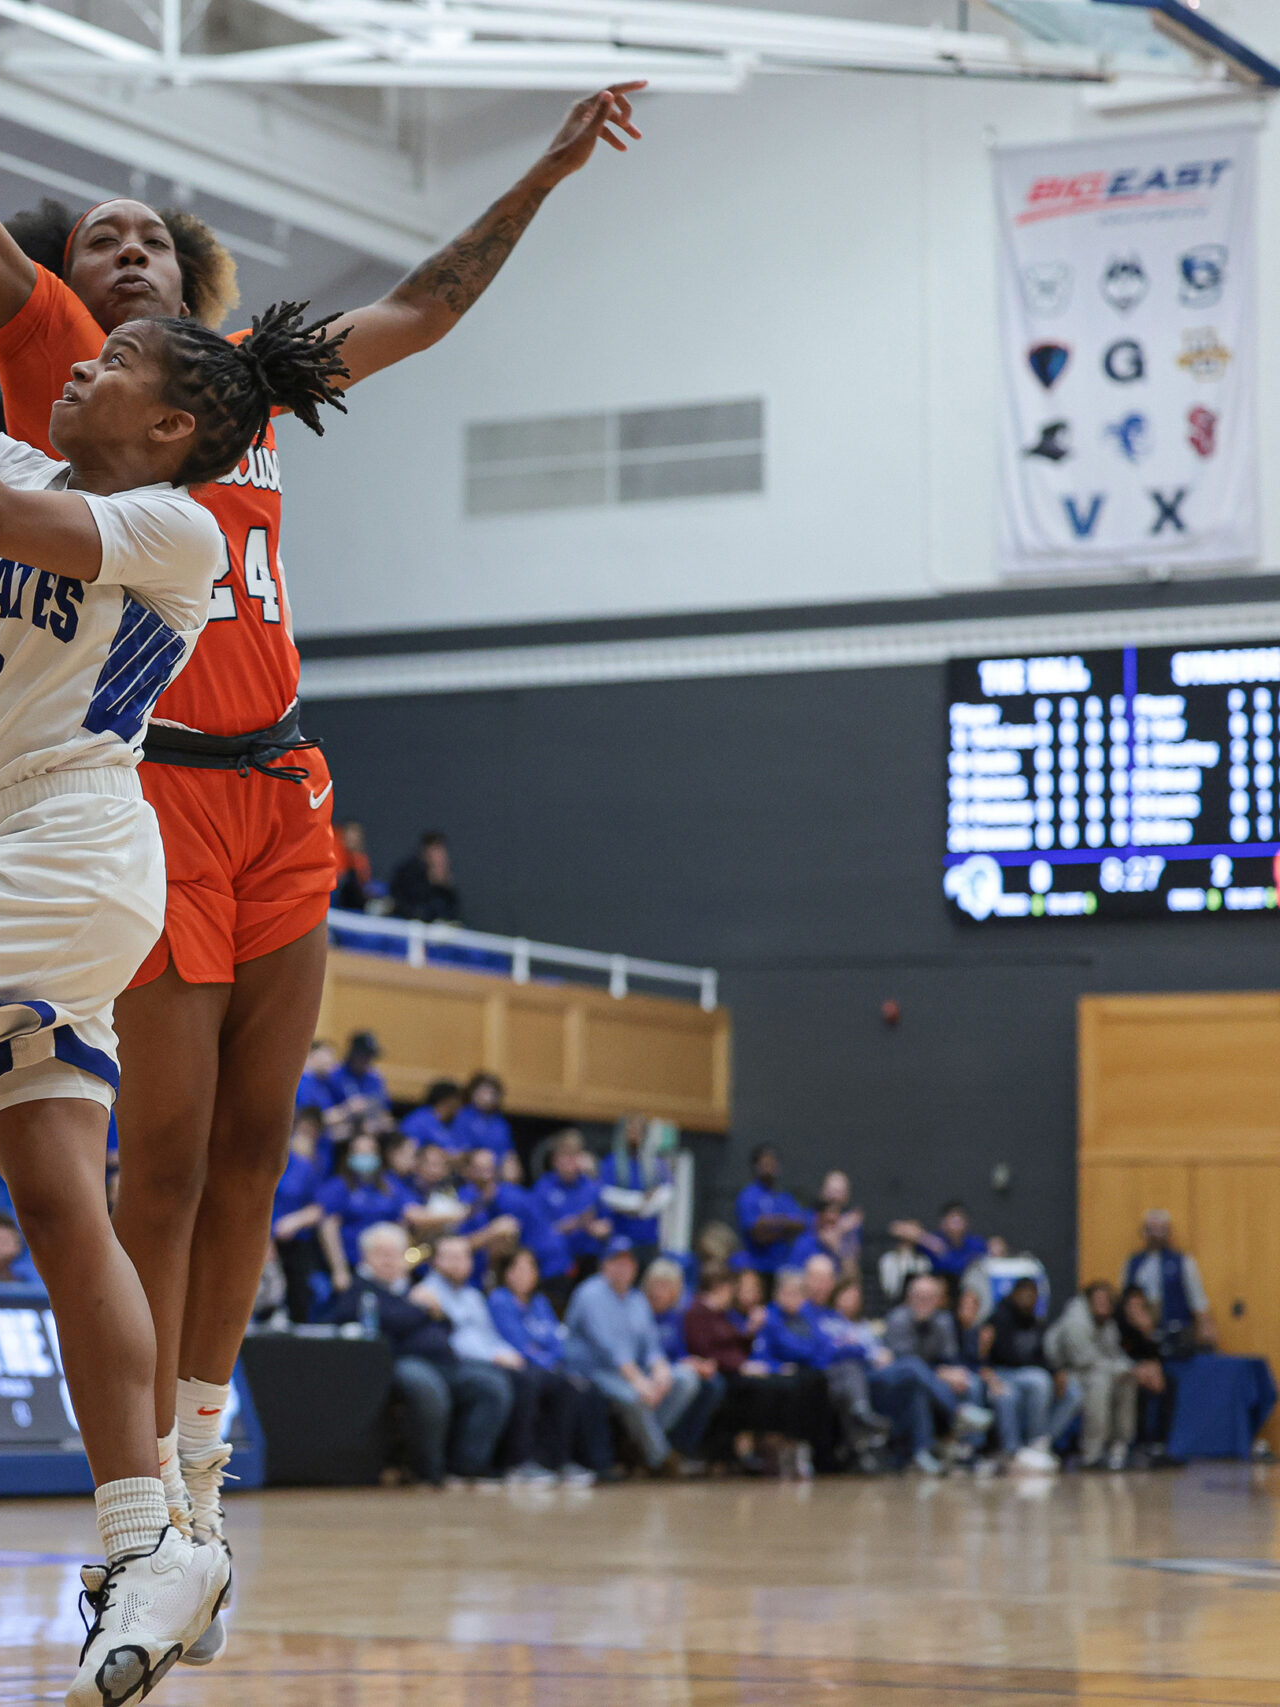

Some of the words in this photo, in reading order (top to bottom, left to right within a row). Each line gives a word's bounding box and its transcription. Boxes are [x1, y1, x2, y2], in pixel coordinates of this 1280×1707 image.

[1106, 157, 1233, 197] EAST
[1102, 334, 1145, 385] G
[1062, 491, 1108, 536] V
[1147, 486, 1189, 535] X
[207, 525, 281, 625] 24
